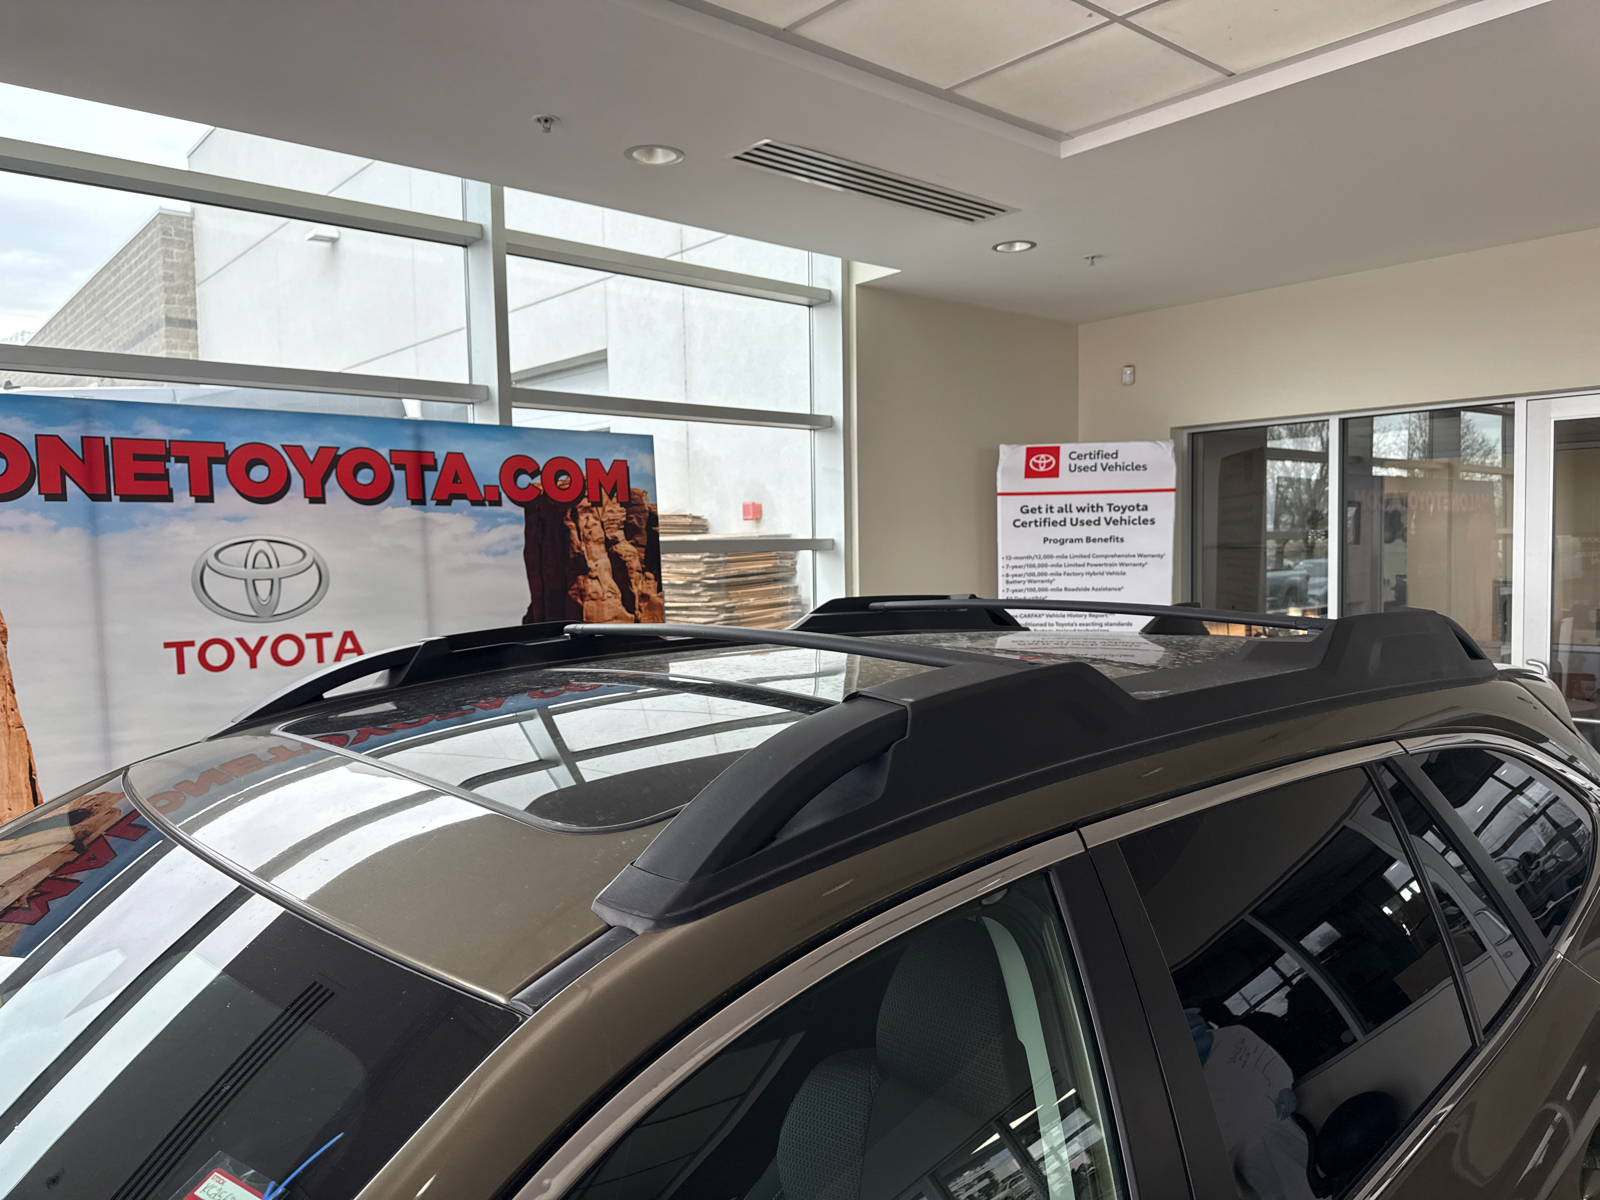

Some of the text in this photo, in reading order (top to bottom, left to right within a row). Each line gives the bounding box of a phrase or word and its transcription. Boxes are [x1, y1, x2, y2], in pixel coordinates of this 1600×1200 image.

[1068, 449, 1118, 461] Certified
[1068, 461, 1148, 473] Used Vehicles
[1020, 503, 1148, 515] Get it all with Toyota
[1012, 515, 1156, 528] Certified Used Vehicles
[1043, 535, 1124, 546] Program Benefits
[1091, 552, 1136, 561] Comprehensive
[1063, 570, 1084, 578] Factory
[1085, 570, 1105, 578] Hybrid
[1005, 578, 1026, 586] Battery
[163, 630, 366, 676] TOYOTA
